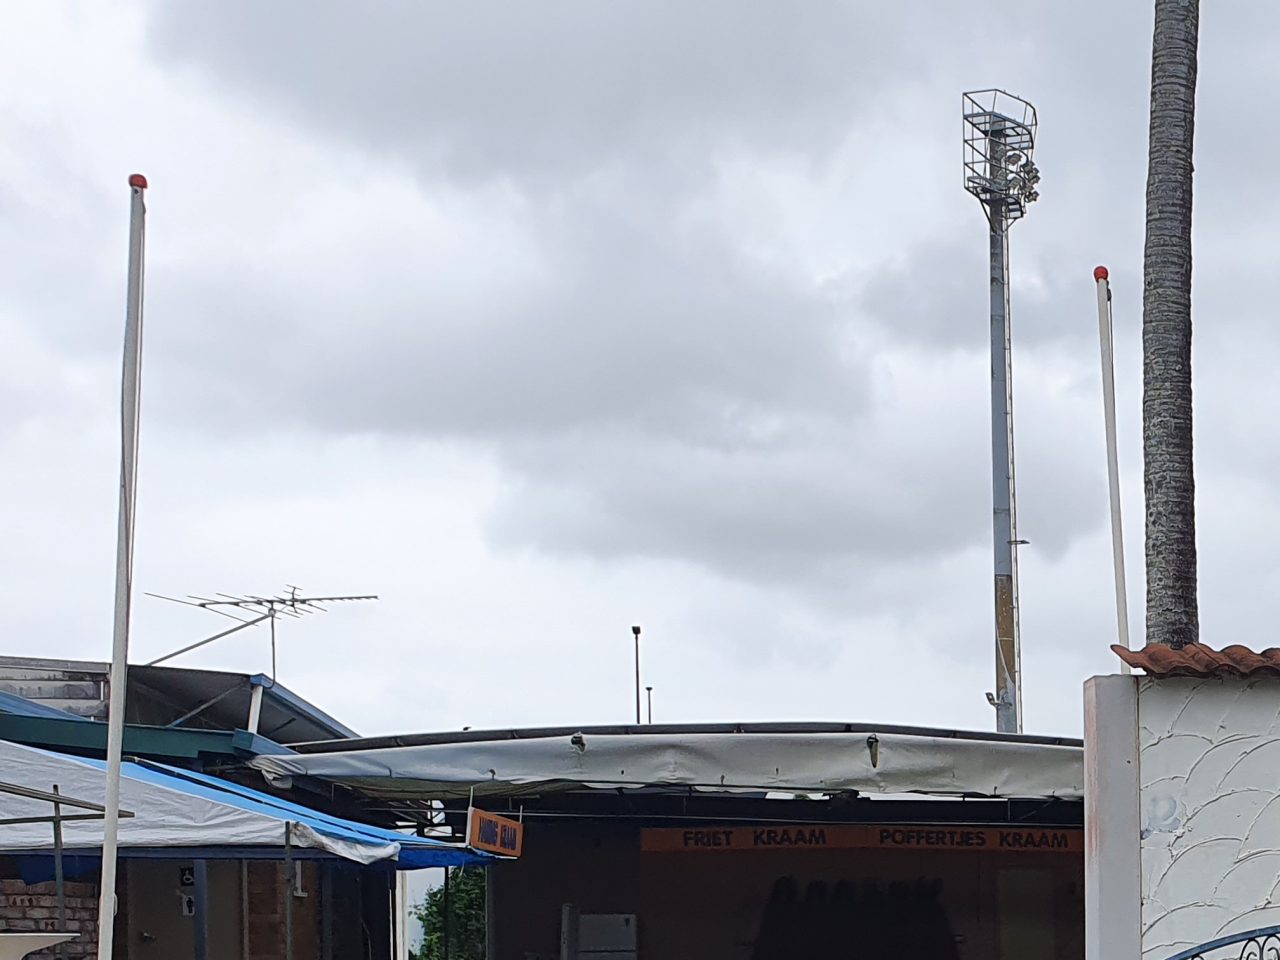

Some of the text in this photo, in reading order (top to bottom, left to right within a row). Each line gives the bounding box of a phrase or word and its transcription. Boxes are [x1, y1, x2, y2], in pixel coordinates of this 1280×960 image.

[683, 829, 827, 846] FRIET KRAAM
[880, 829, 1068, 848] POFFERTJES KRAAM
